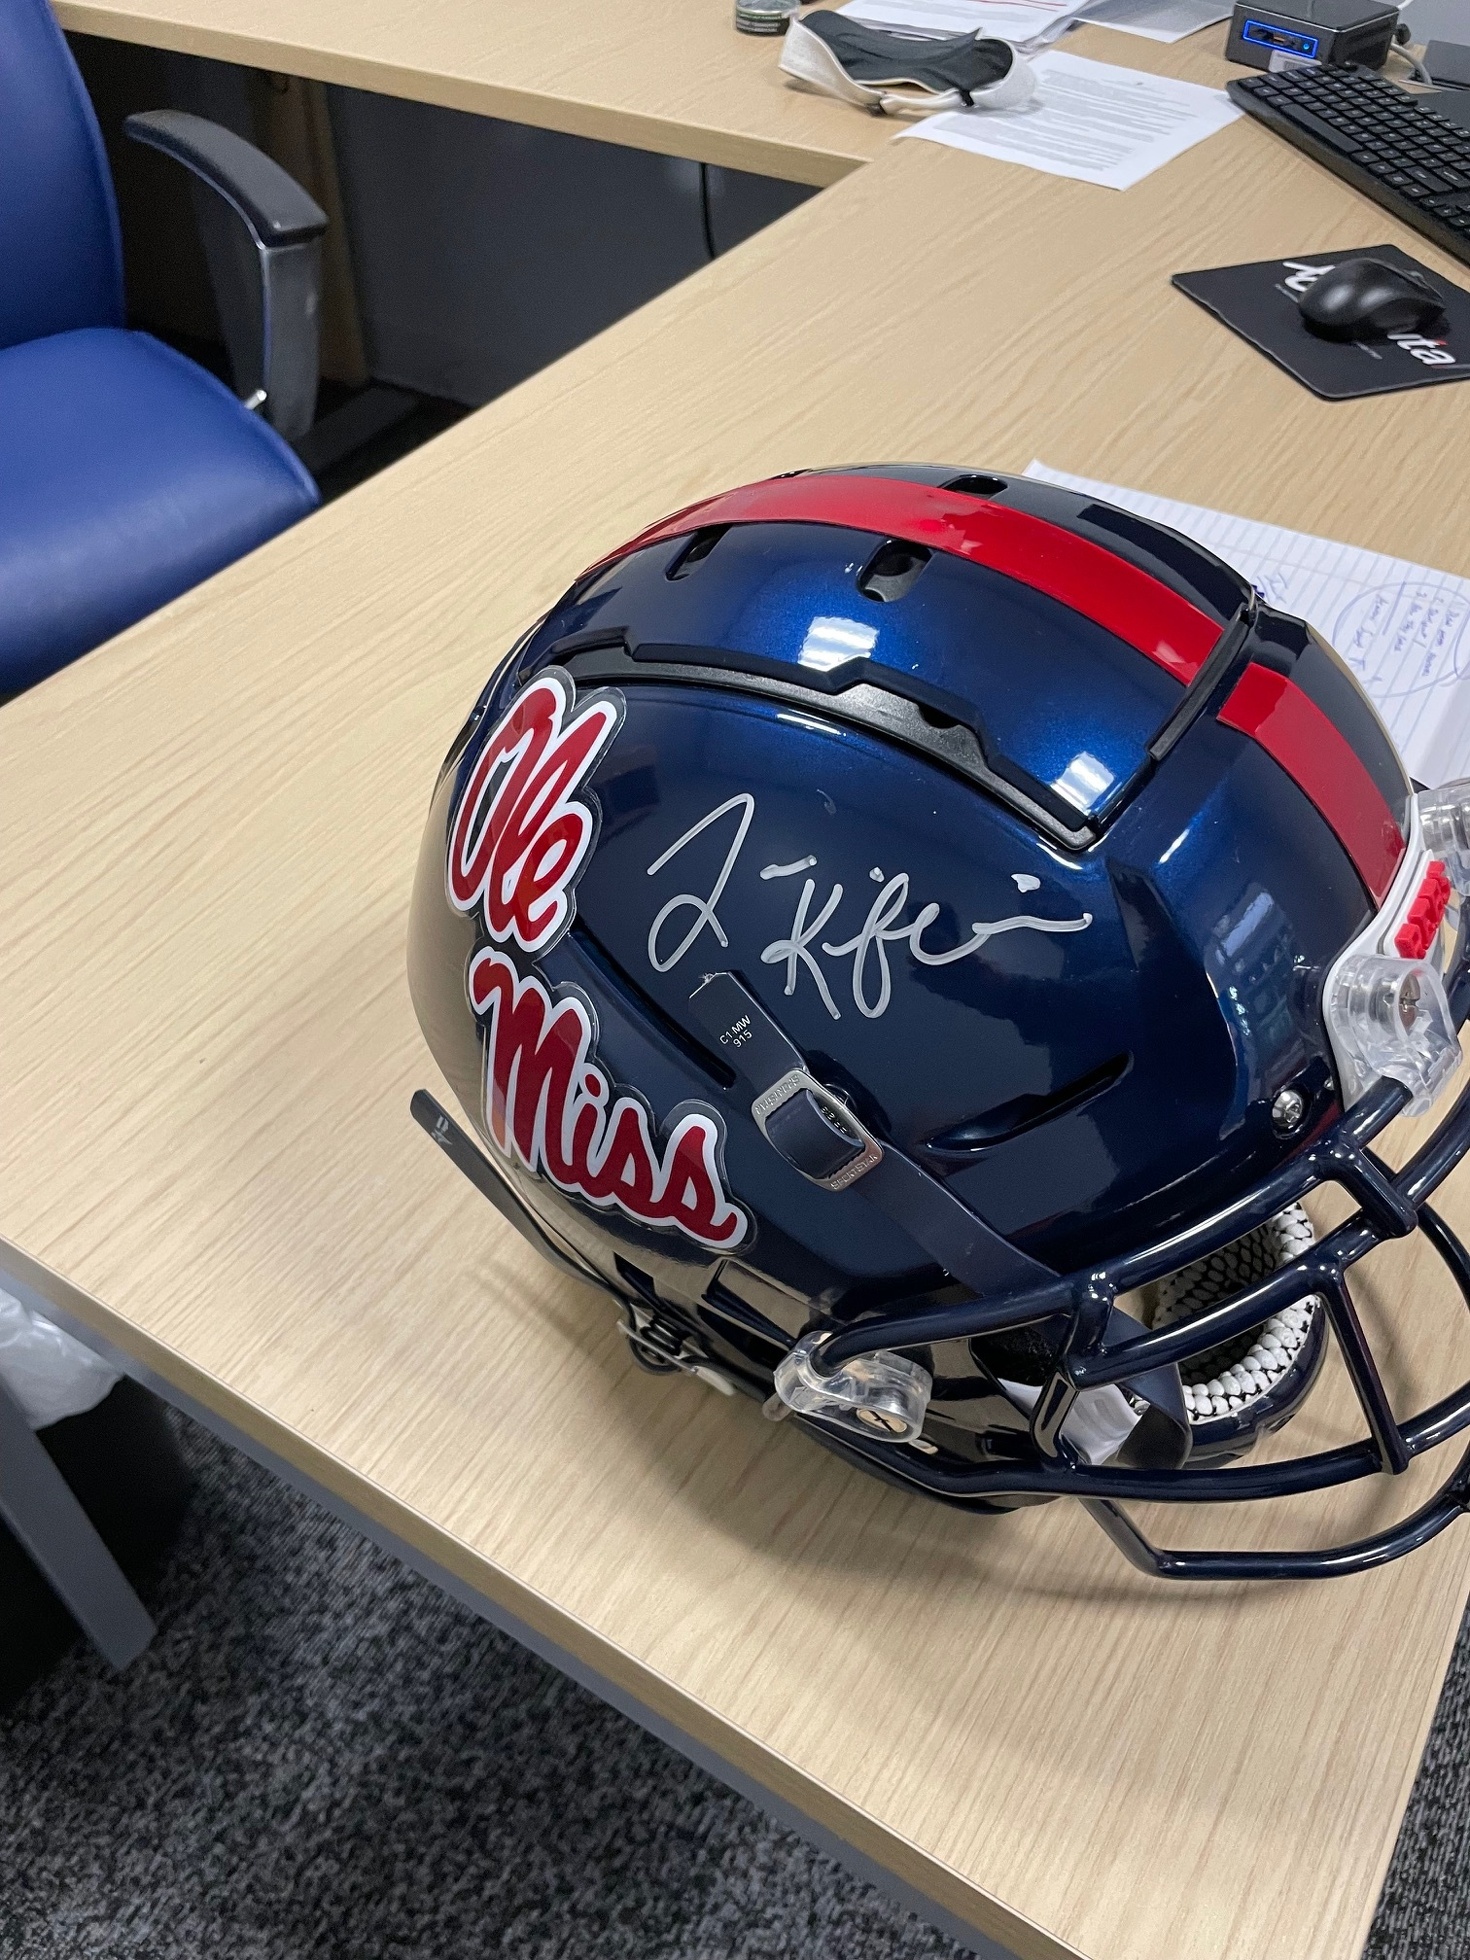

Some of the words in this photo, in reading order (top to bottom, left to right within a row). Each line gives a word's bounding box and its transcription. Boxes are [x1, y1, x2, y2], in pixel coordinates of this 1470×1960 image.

[450, 678, 615, 951] Ole
[470, 948, 747, 1247] Miss
[719, 1031, 733, 1045] C1
[731, 1014, 751, 1035] MW
[733, 1029, 753, 1048] 915
